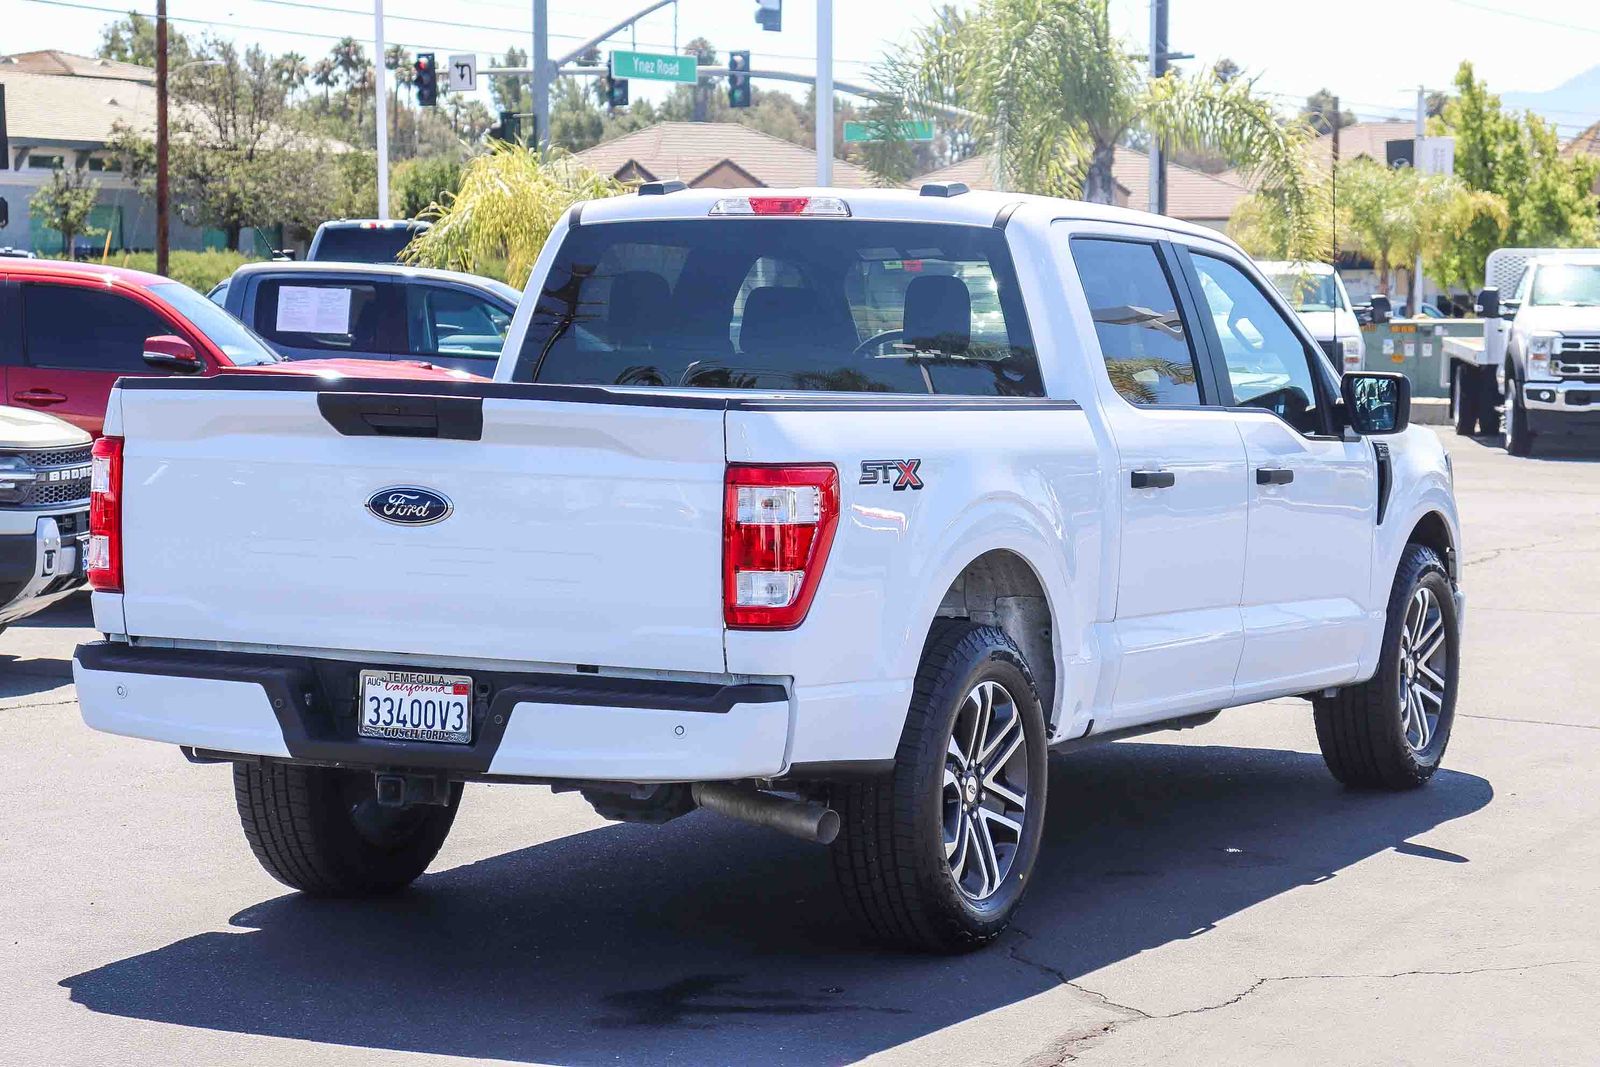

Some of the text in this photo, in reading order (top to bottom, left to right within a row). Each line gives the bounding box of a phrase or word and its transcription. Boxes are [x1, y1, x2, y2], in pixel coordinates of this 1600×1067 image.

[632, 55, 680, 75] Ynez Road
[859, 459, 924, 491] STX
[383, 493, 431, 517] Ford
[387, 672, 445, 685] TEMECULA
[368, 696, 464, 731] 33400V3
[420, 730, 445, 740] FORD
